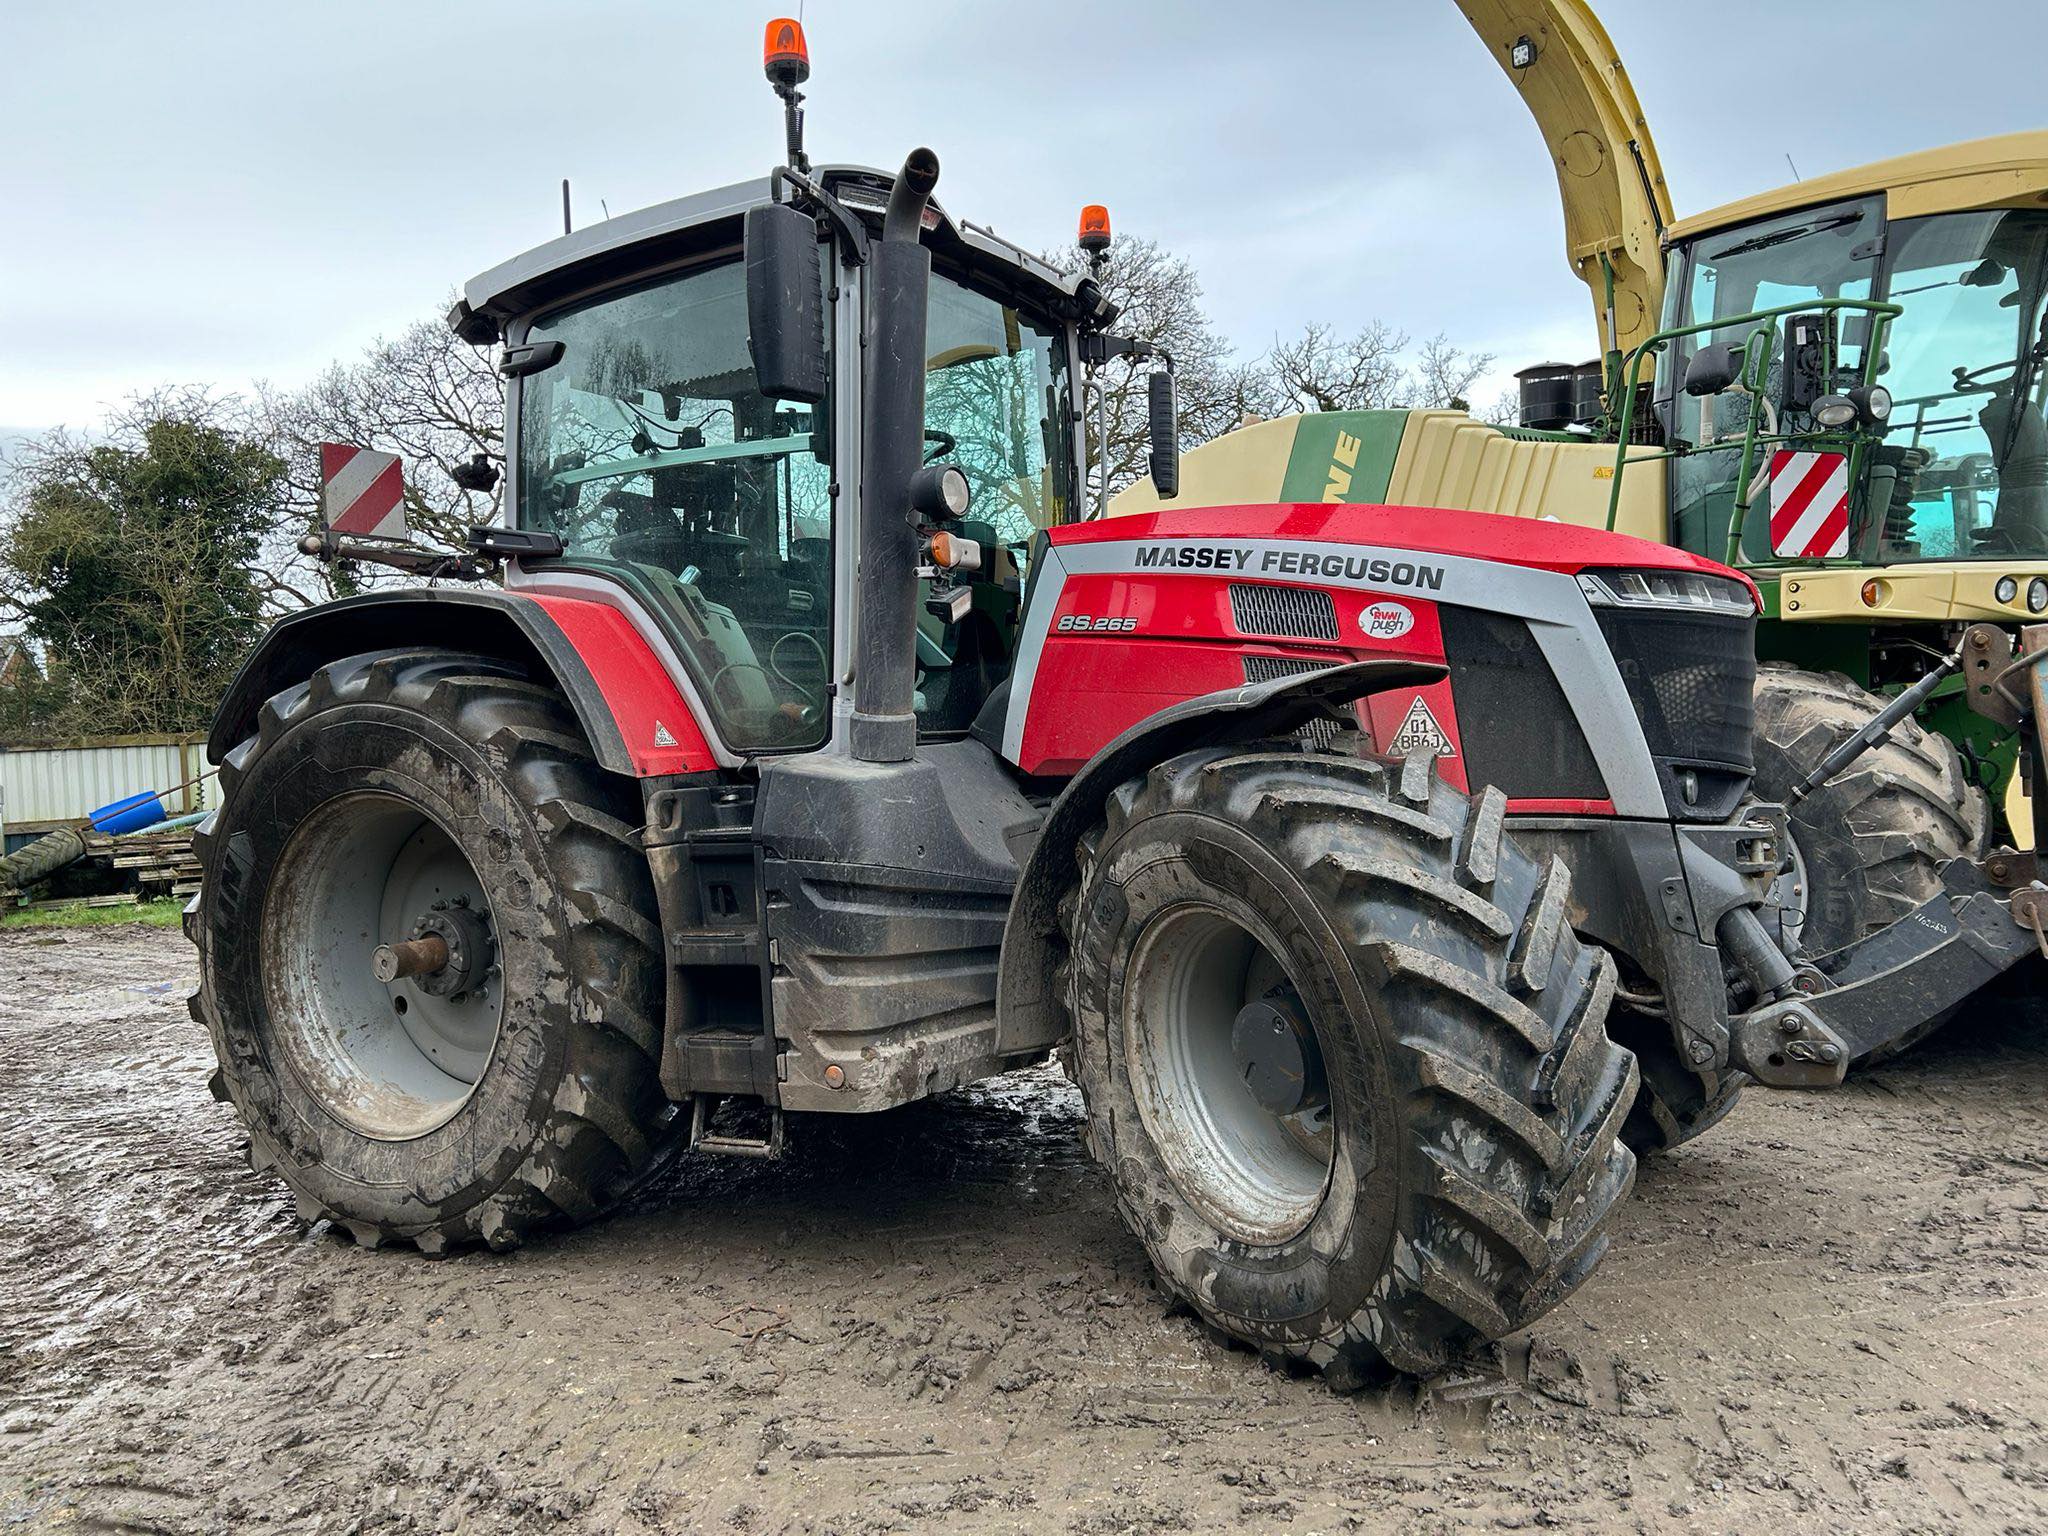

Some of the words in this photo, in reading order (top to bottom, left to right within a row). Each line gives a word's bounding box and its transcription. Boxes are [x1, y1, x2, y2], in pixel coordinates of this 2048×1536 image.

[1134, 547, 1253, 570] MASSEY
[1261, 551, 1445, 590] FERGUSON
[1057, 615, 1138, 631] 8S.265
[1370, 612, 1404, 634] pugh
[1411, 718, 1429, 734] 01
